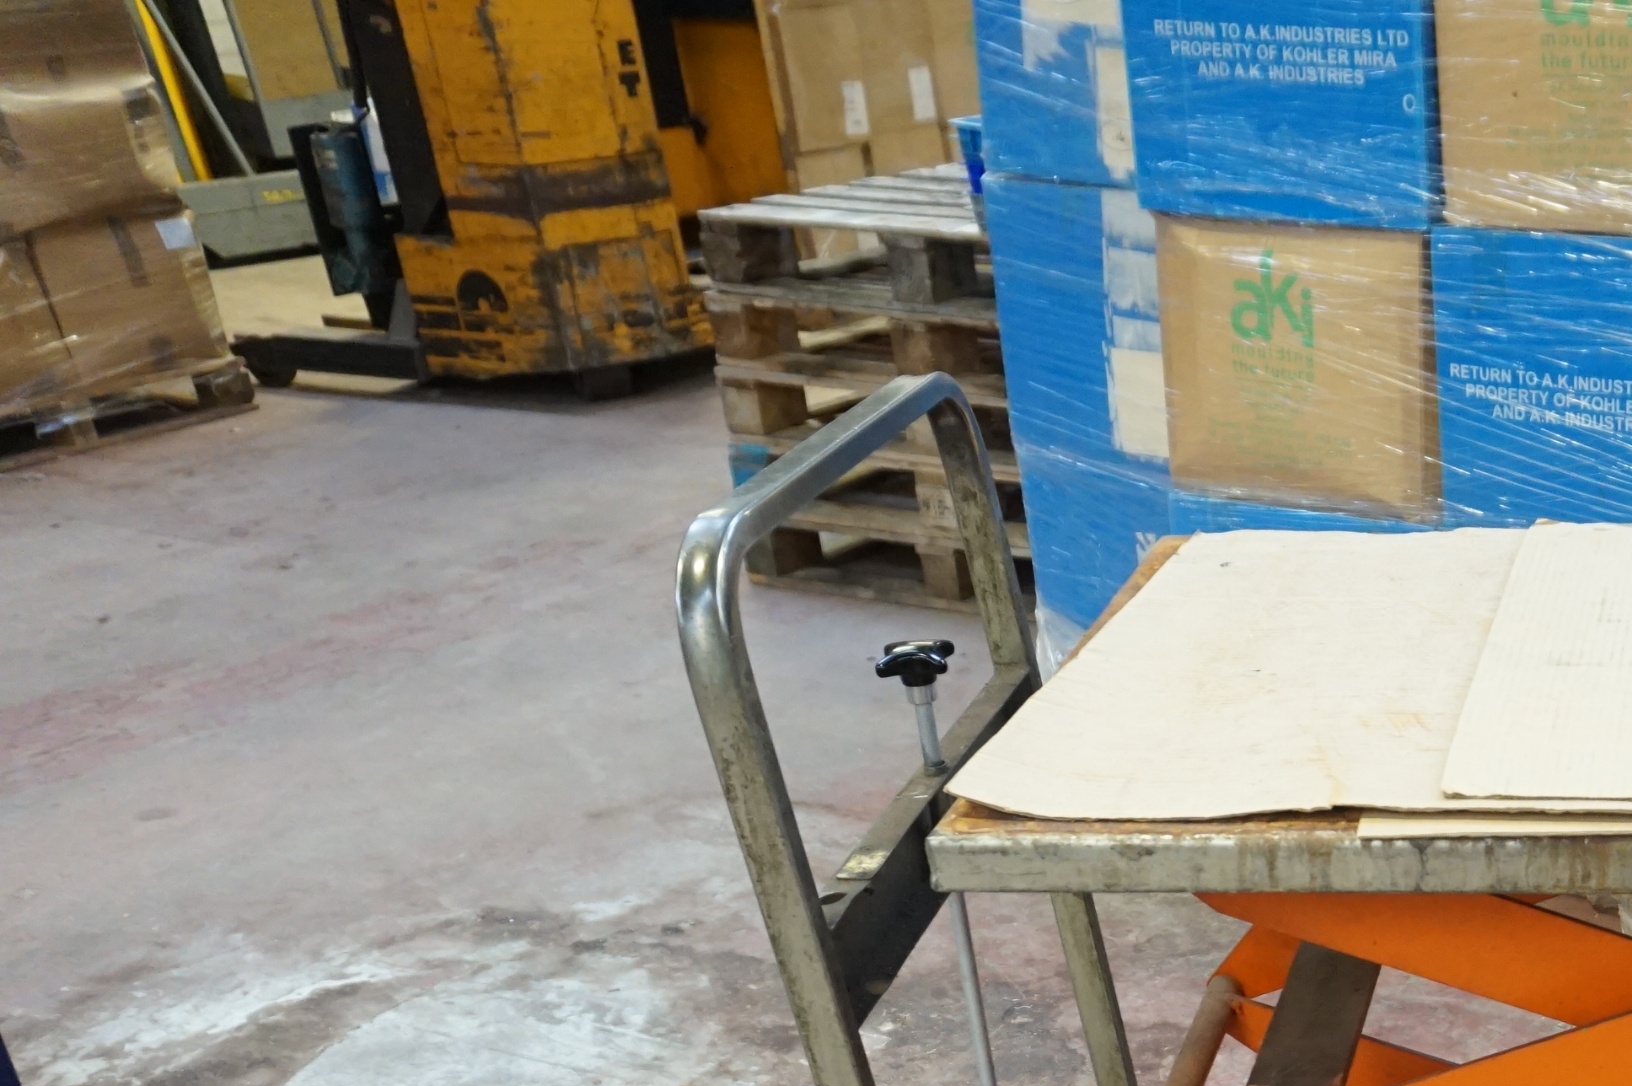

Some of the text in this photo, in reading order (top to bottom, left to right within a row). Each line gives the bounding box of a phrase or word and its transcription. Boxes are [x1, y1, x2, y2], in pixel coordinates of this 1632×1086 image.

[1154, 19, 1215, 38] RETURN
[1219, 22, 1240, 40] TO
[1377, 29, 1409, 47] LTD
[1170, 40, 1397, 68] PROPERTY OF KOHLER MIRA
[1541, 54, 1572, 69] the
[1198, 61, 1365, 86] AND A.K. INDUSTRIES
[1231, 344, 1314, 369] moulding
[1232, 359, 1314, 383] the future
[1449, 363, 1512, 385] RETURN
[1516, 369, 1537, 386] TO
[1465, 384, 1549, 405] PROPERTY
[1553, 392, 1577, 407] OF
[1491, 404, 1526, 421] AND
[1530, 409, 1560, 425] A.K.
